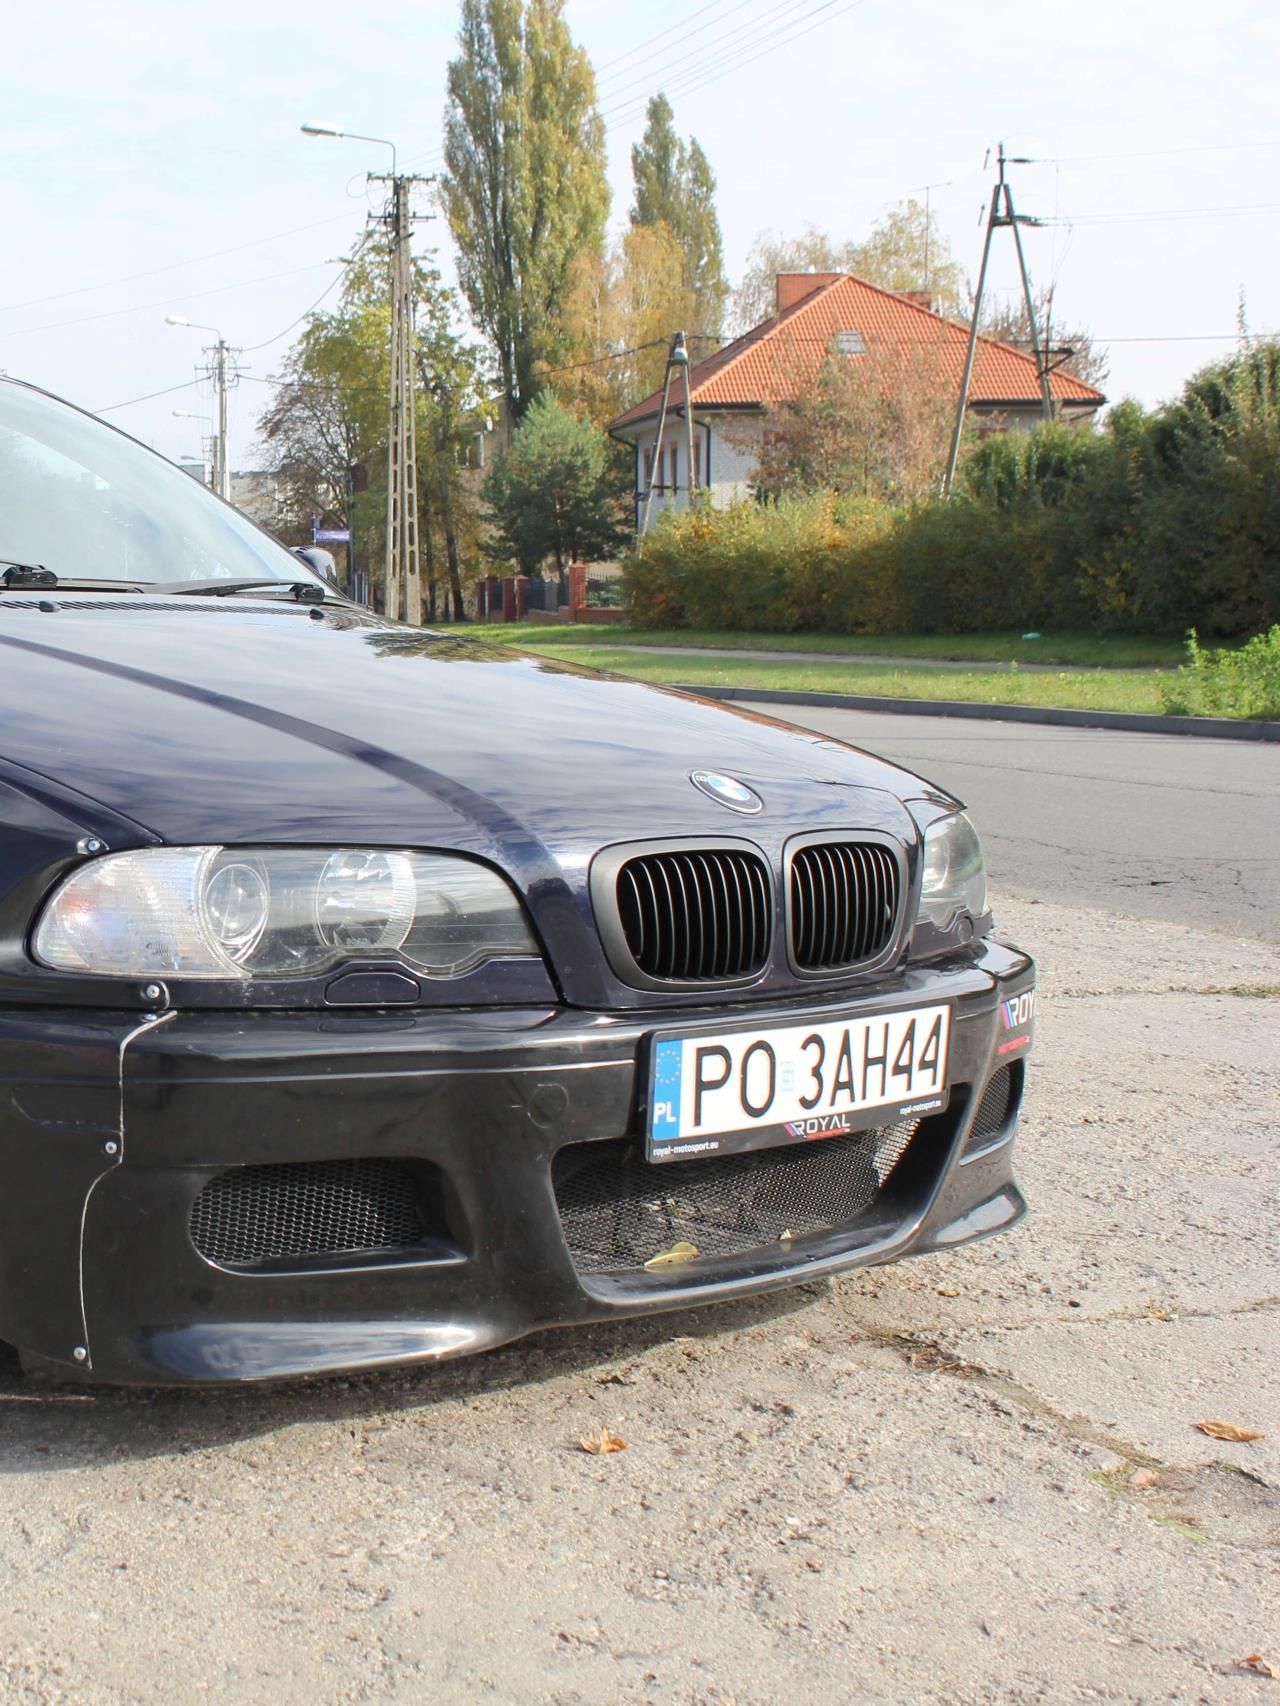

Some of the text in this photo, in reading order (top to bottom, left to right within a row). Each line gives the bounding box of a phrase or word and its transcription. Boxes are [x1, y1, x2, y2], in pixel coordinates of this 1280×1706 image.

[1008, 988, 1037, 1027] ROY
[692, 1013, 943, 1128] PO 3AH44
[653, 1101, 677, 1125] PL
[792, 1113, 852, 1136] ROYAL
[652, 1141, 719, 1158] royal-motosport.eu
